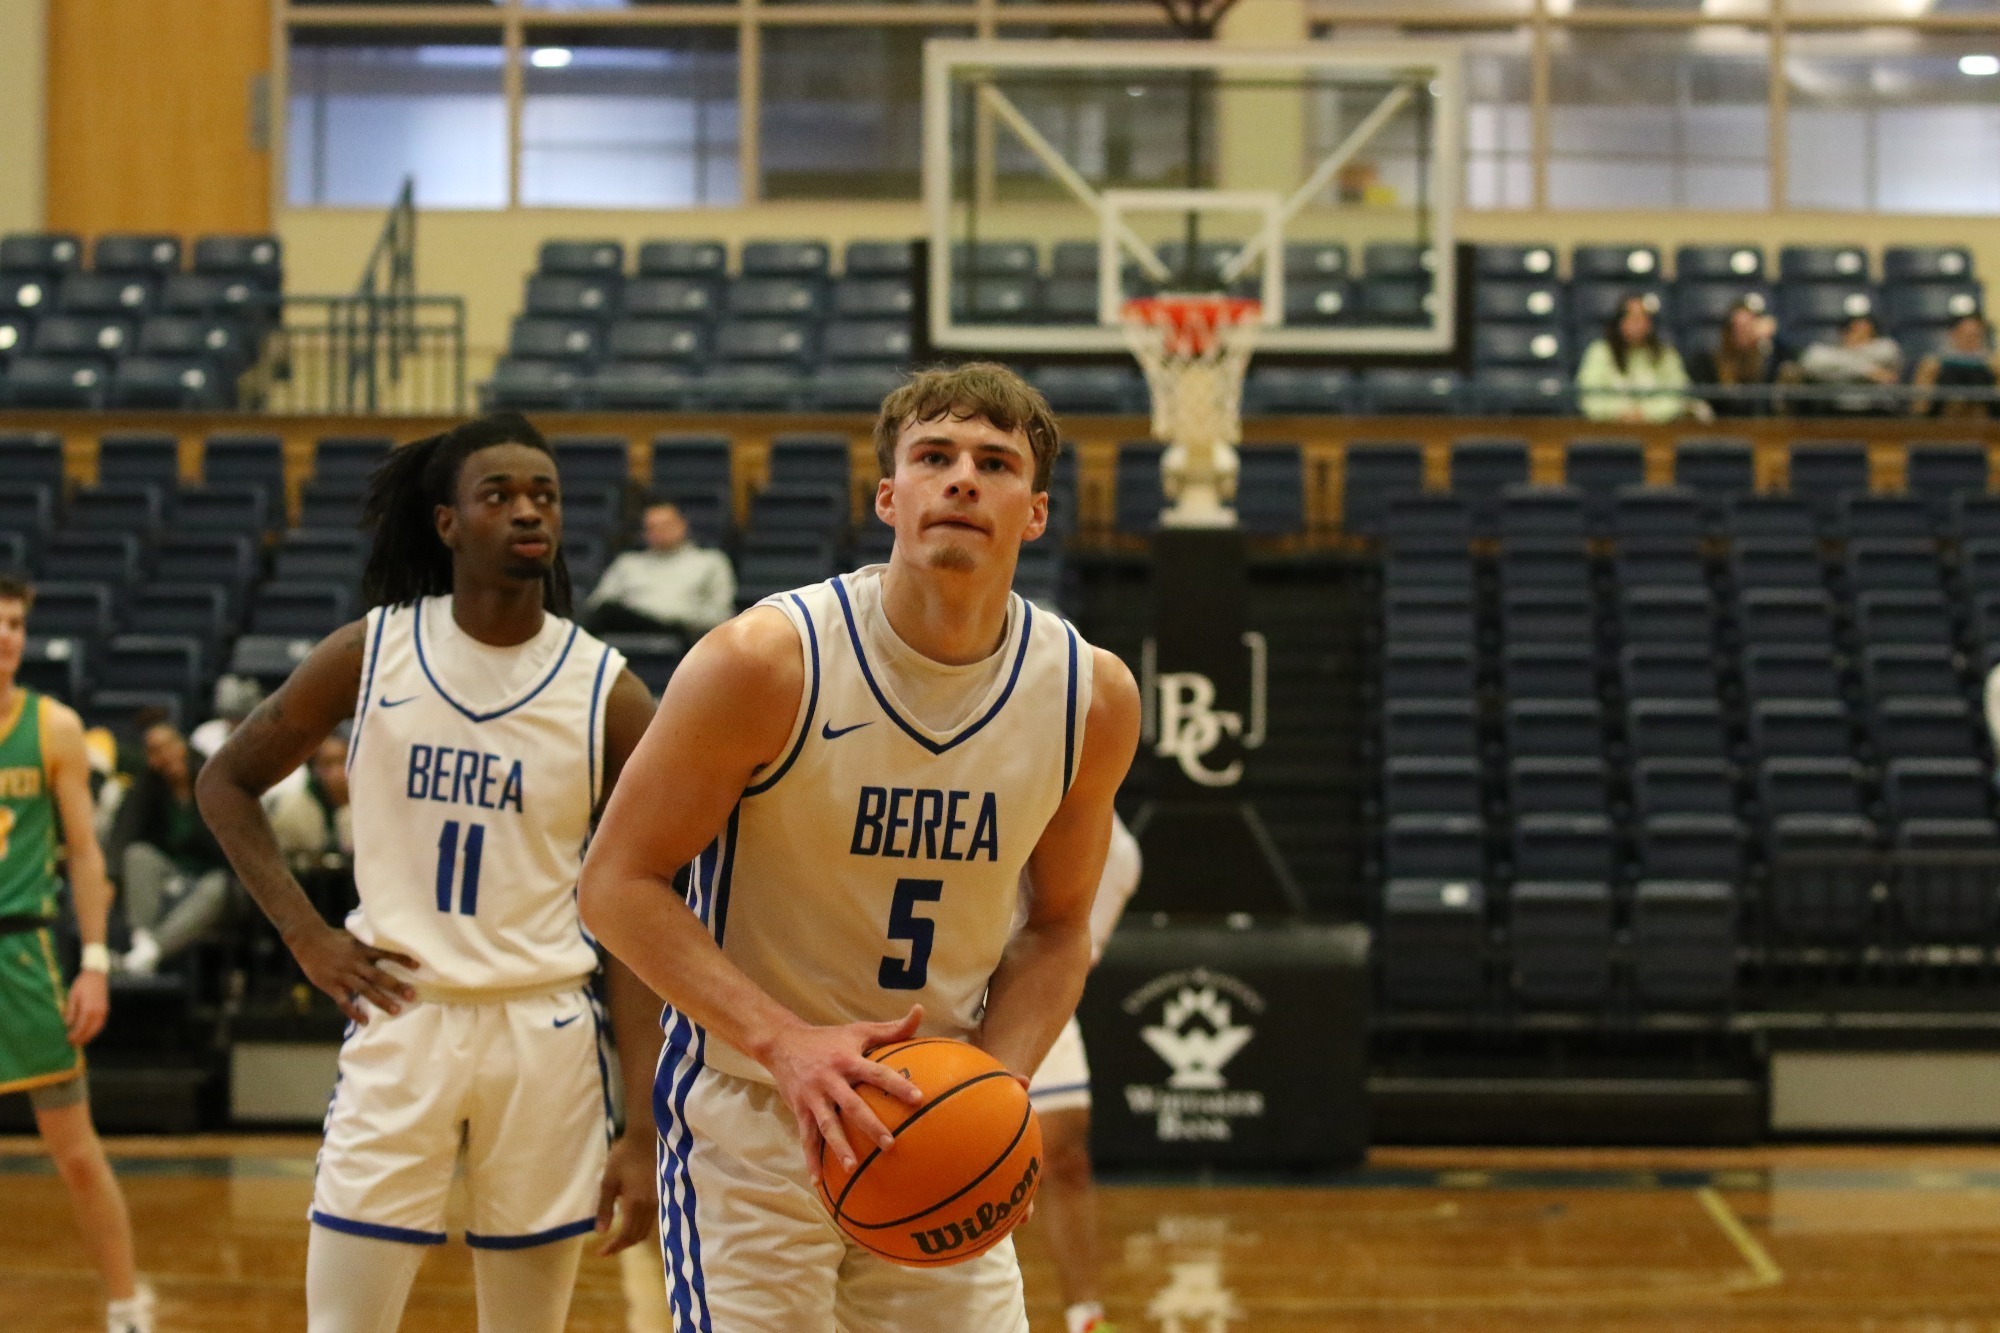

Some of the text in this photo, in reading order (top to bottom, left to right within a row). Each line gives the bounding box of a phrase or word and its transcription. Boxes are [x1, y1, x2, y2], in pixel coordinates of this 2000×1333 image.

[407, 743, 523, 814] BEREA
[850, 786, 998, 862] BEREA
[436, 819, 485, 916] 11
[878, 878, 944, 990] 5
[910, 1156, 1039, 1255] Wilson
